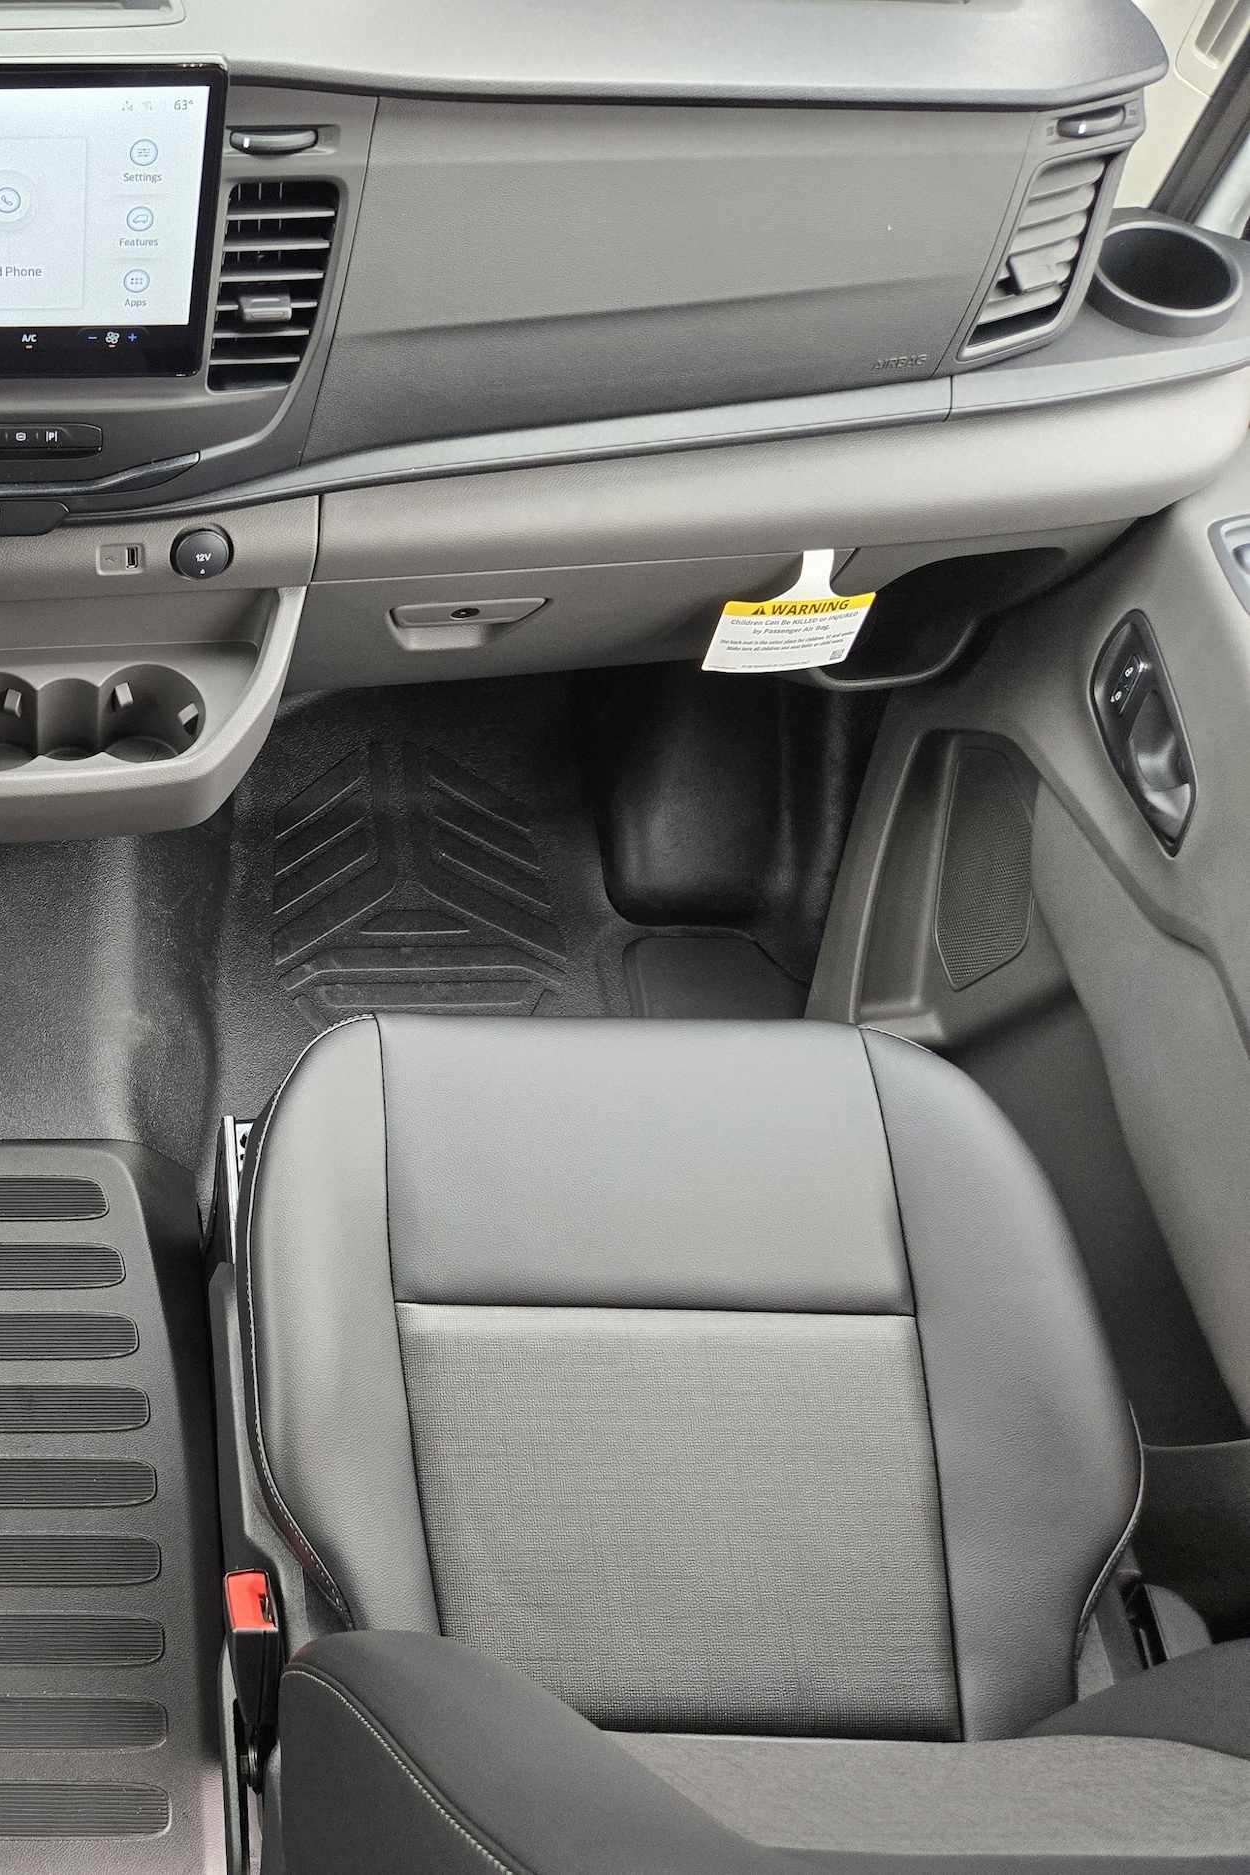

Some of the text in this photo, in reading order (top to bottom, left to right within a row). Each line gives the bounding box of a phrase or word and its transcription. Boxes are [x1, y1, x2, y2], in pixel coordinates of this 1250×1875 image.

[123, 172, 163, 183] Settings
[118, 236, 160, 247] Features
[5, 265, 43, 278] Phone
[124, 298, 148, 309] Apps
[21, 333, 38, 344] A/C
[871, 353, 928, 371] AIRBAG
[195, 553, 212, 563] 12V
[771, 599, 851, 616] WARNING
[792, 617, 819, 625] KILLED
[828, 611, 859, 621] INJURED
[752, 628, 763, 636] by
[763, 627, 802, 635] Passenger
